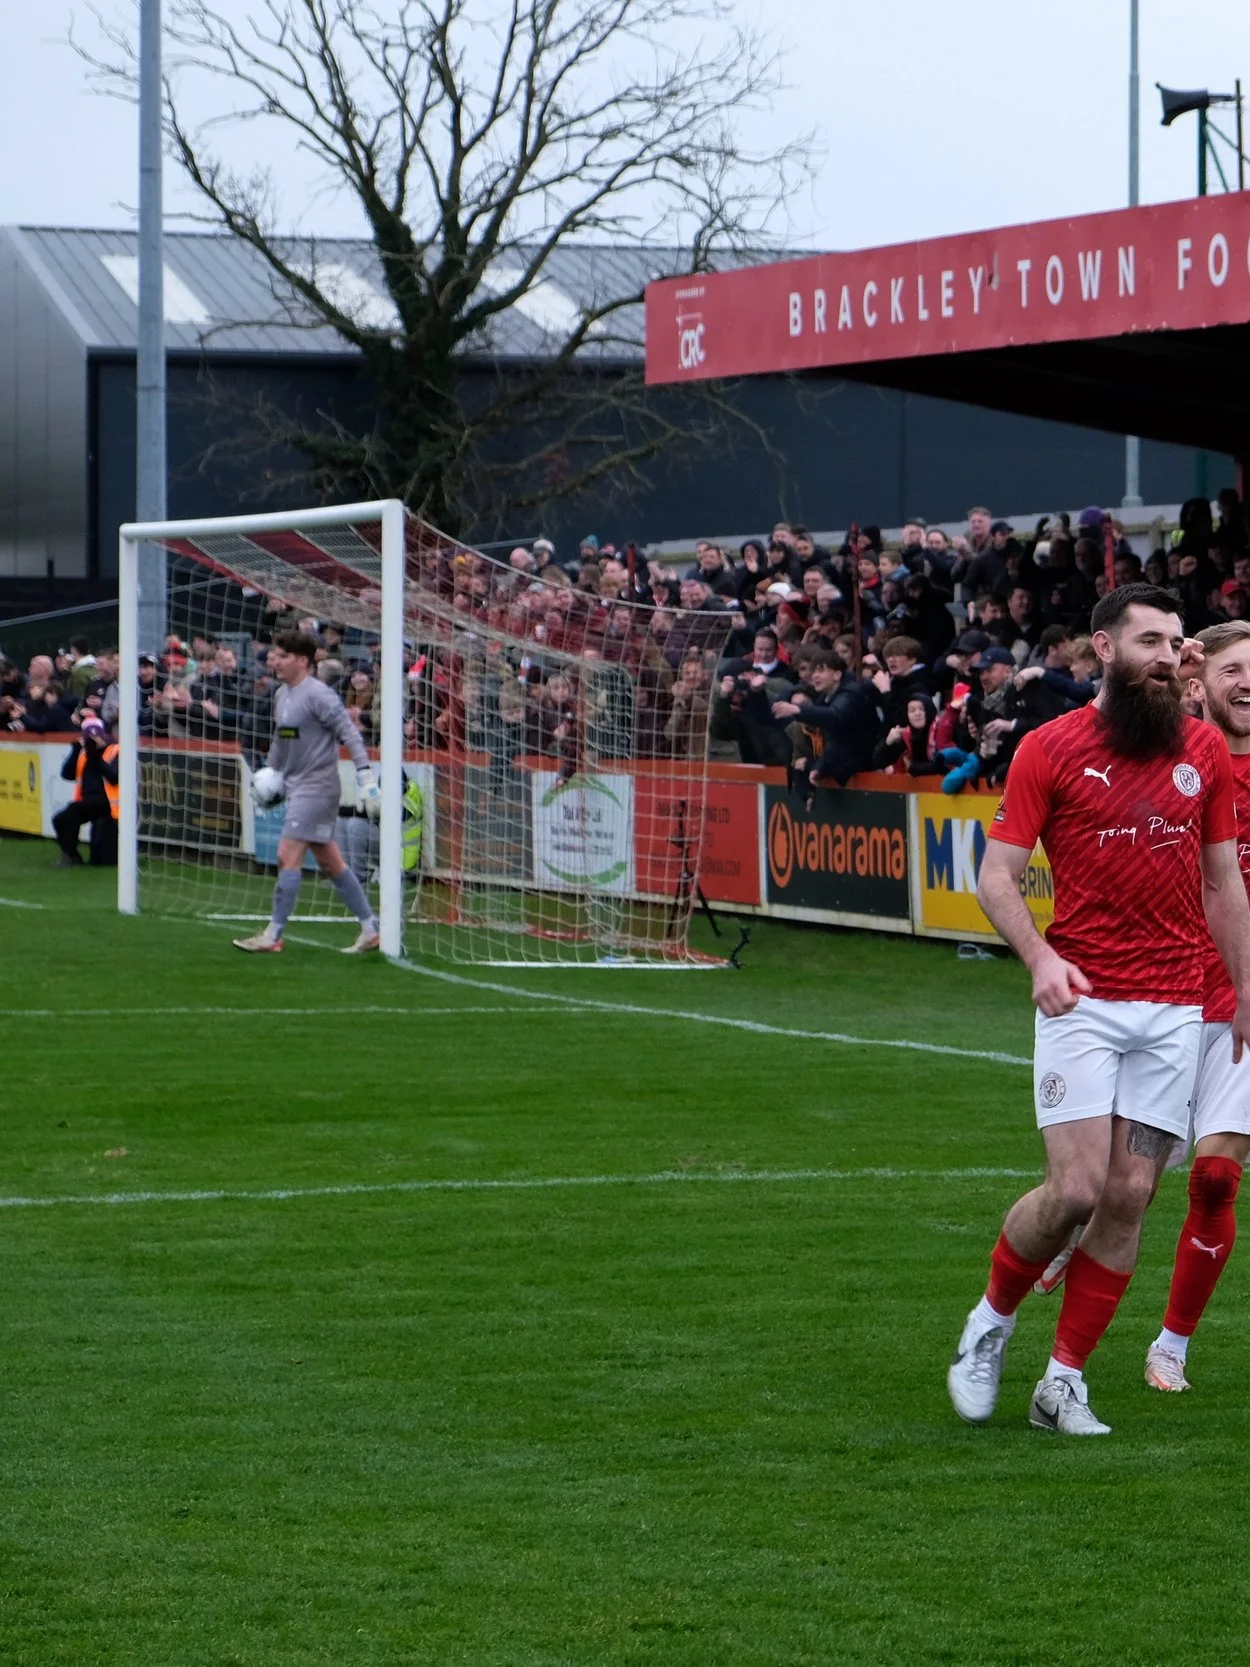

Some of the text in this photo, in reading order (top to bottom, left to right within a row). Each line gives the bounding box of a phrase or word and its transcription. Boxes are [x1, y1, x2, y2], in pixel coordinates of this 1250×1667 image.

[789, 266, 984, 336] BRACKLEY
[1017, 245, 1136, 308] TOWN
[793, 821, 906, 880] vanarama
